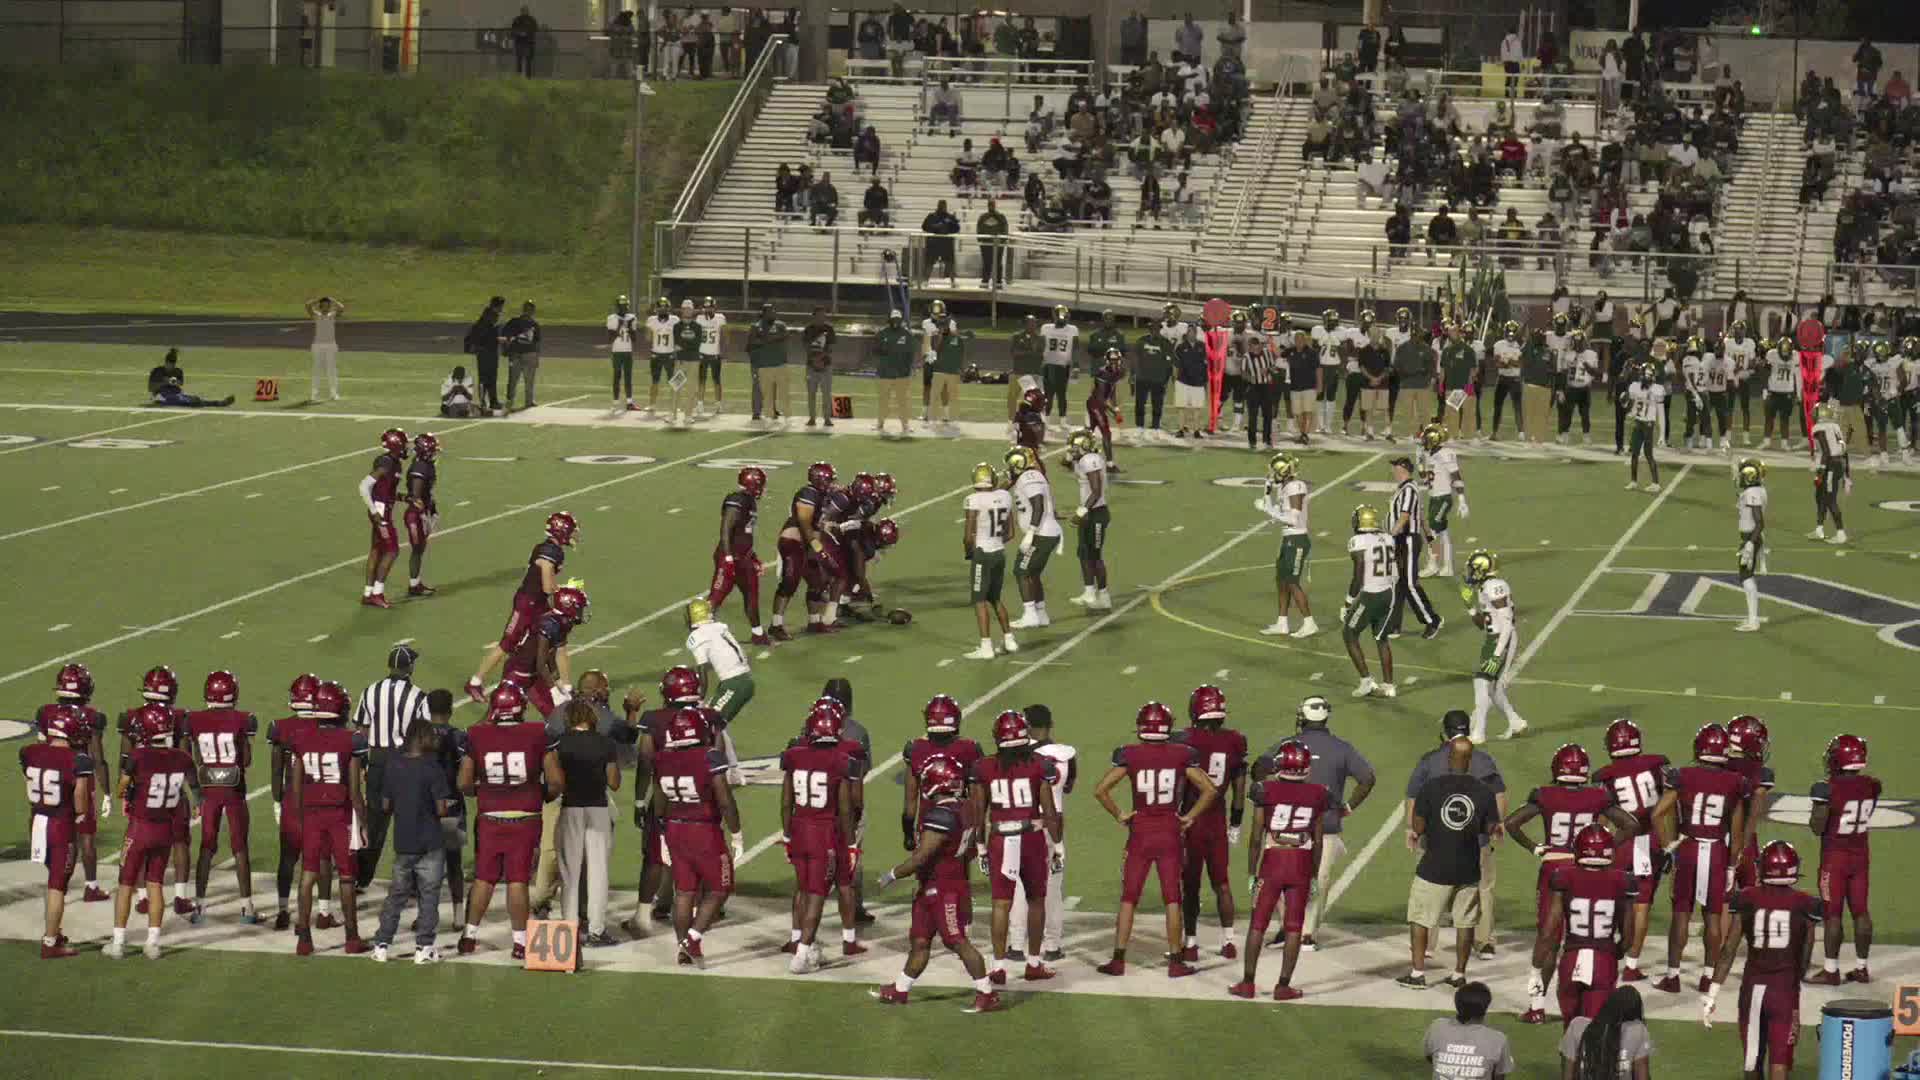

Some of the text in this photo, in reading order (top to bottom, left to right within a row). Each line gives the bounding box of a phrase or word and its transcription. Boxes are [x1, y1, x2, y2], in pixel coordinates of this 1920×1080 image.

[1262, 308, 1277, 330] 2
[988, 507, 1008, 538] 15
[990, 778, 1033, 809] 40
[1136, 769, 1176, 805] 49
[1614, 771, 1659, 812] 30
[1691, 792, 1726, 826] 12
[1570, 898, 1616, 938] 22
[1753, 908, 1791, 949] 10
[529, 923, 573, 963] 40
[1843, 1023, 1853, 1080] POWERAD
